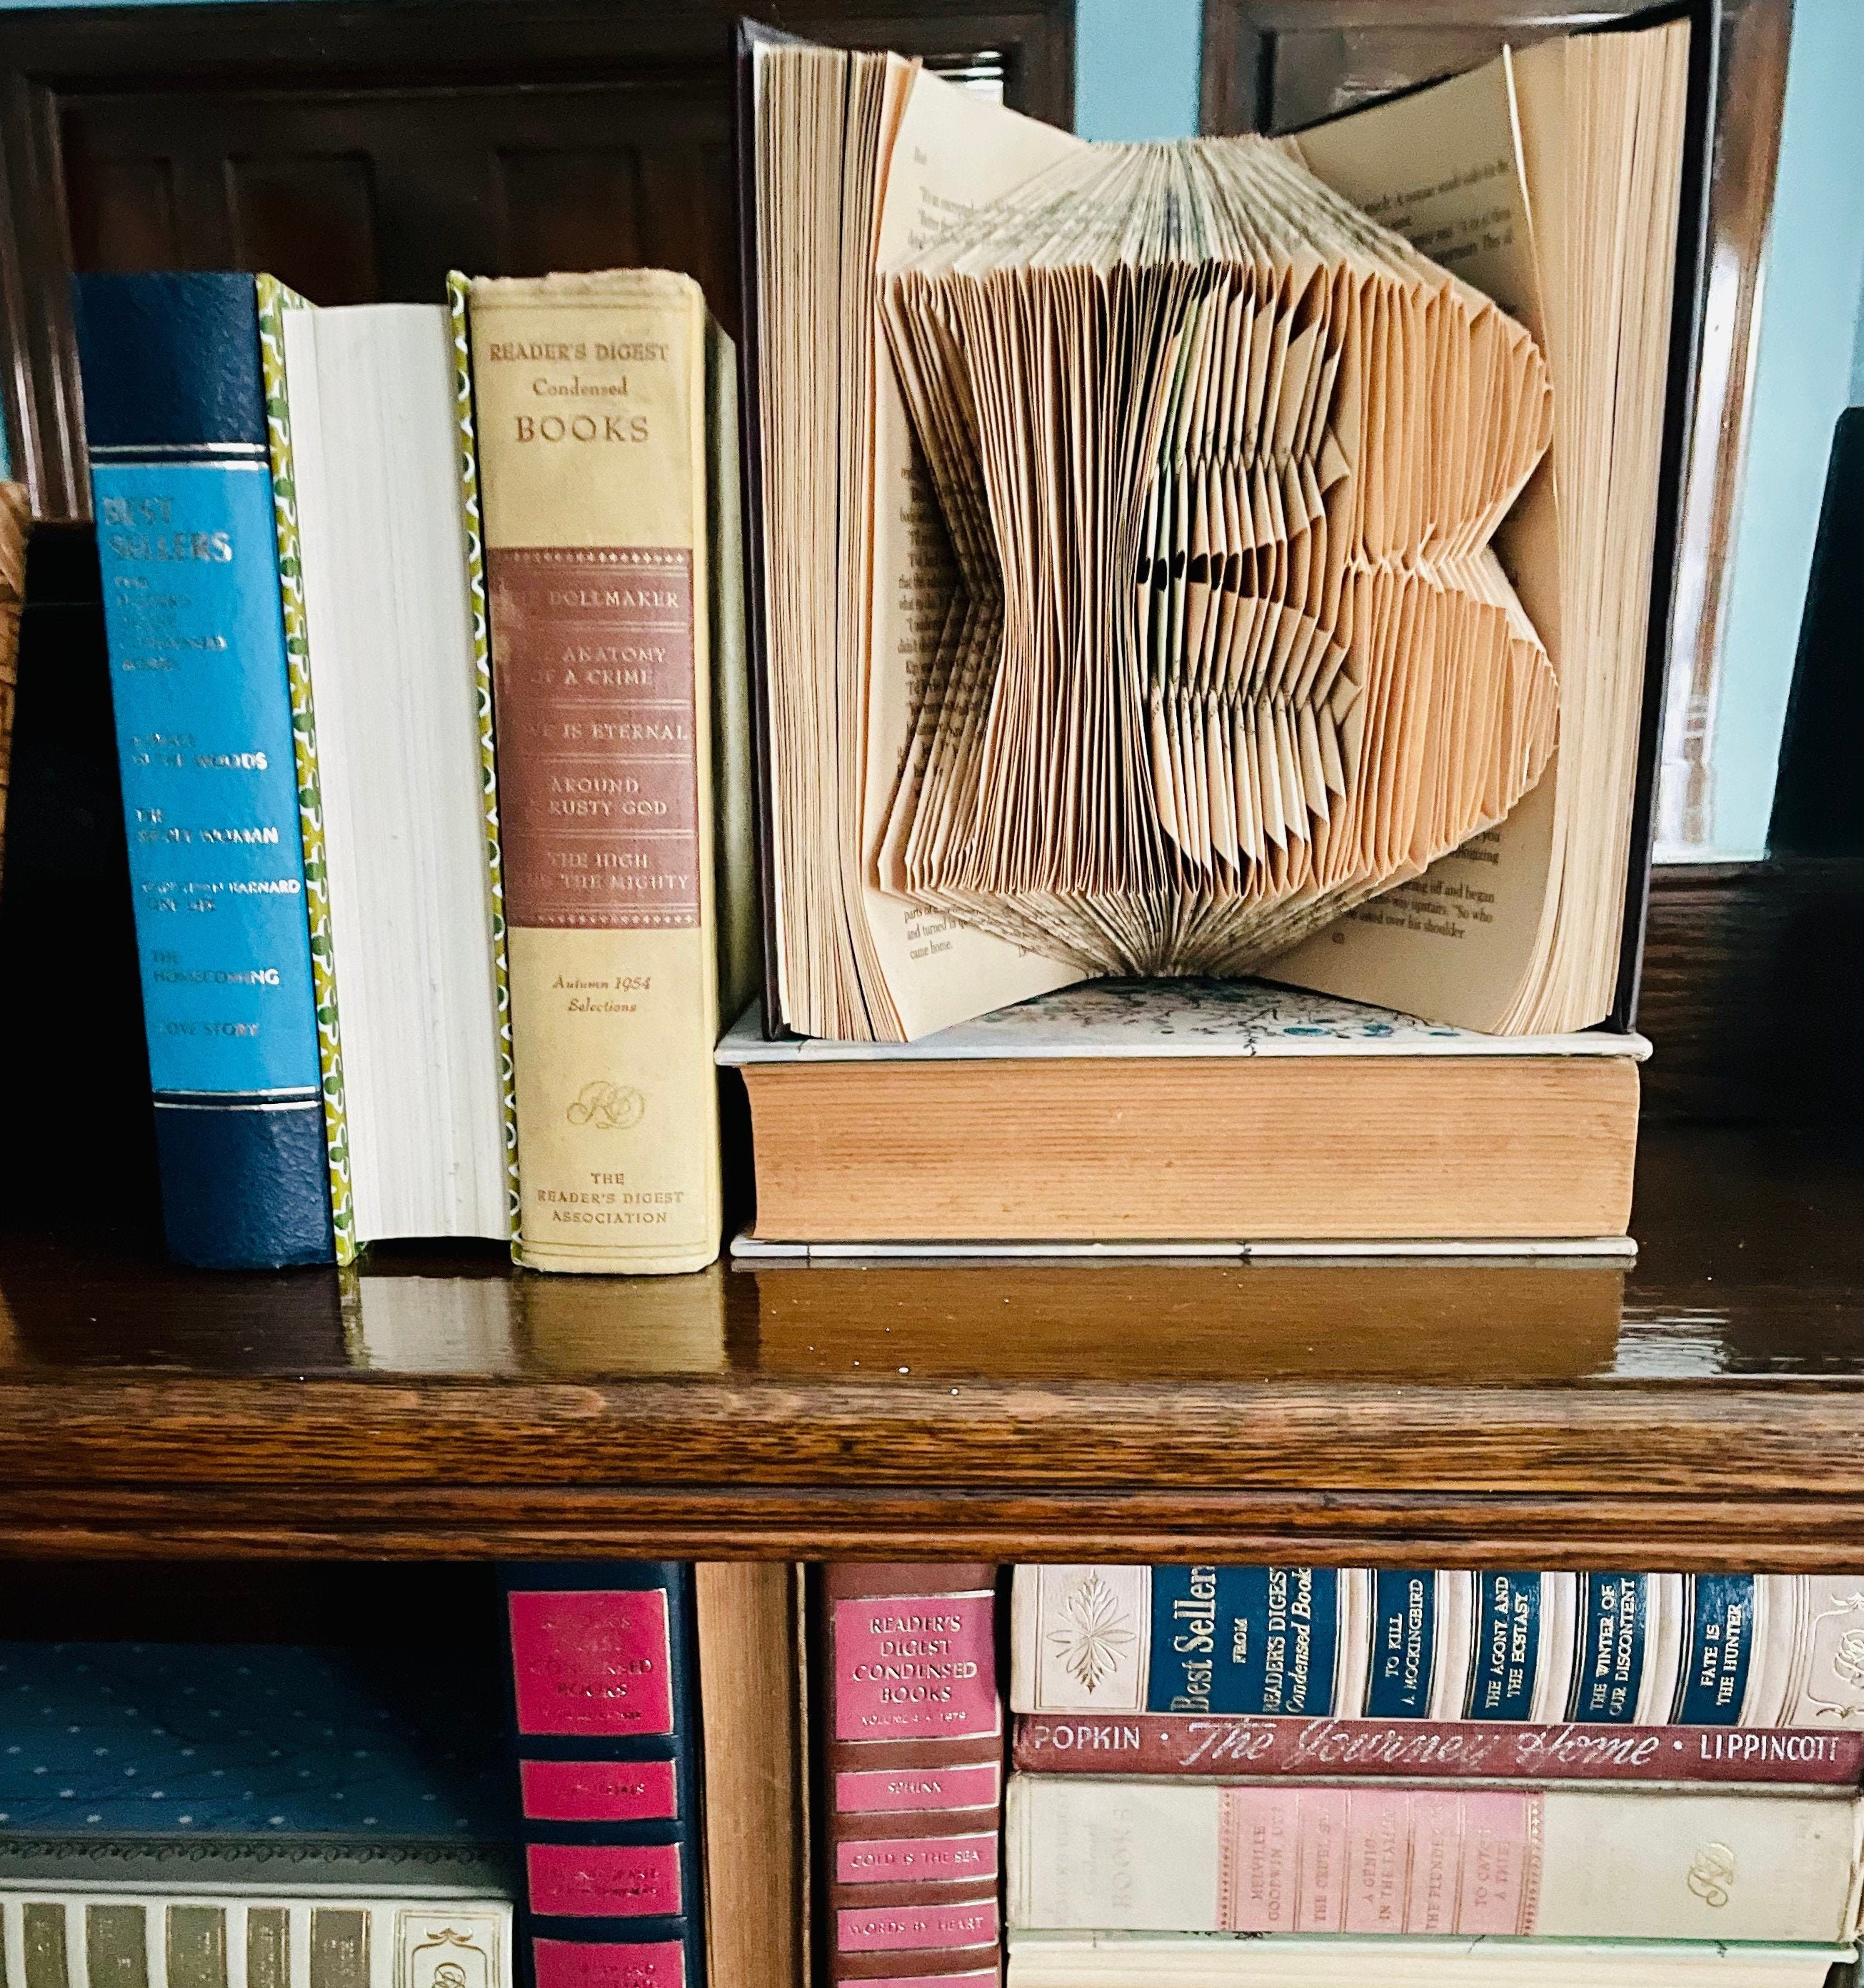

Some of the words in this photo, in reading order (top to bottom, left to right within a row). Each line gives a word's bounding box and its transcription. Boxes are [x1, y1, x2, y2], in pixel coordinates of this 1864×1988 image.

[489, 342, 587, 361] READER'S
[595, 341, 669, 362] DIGEST
[533, 375, 628, 396] Condensed
[514, 415, 649, 444] BOOKS
[563, 646, 666, 663] ANATOMY
[564, 669, 578, 686] A
[588, 669, 654, 686] CRIME
[563, 723, 583, 740] IS
[593, 723, 690, 741] ETERNAL
[551, 777, 639, 794] AROUND
[548, 800, 612, 817] RUSTY
[621, 800, 668, 815] GOD
[548, 852, 588, 869] THE
[596, 853, 649, 869] HIGH
[561, 873, 603, 890] THE
[610, 874, 690, 891] MIGHTY
[552, 975, 608, 990] Autumn
[614, 976, 651, 990] 1954
[568, 997, 637, 1013] Selections
[591, 1173, 626, 1185] THE
[537, 1190, 616, 1205] READER'S
[623, 1190, 685, 1205] DIGEST
[551, 1210, 668, 1225] ASSOCIATION
[1494, 1576, 1510, 1615] AND
[1601, 1584, 1616, 1610] OF
[868, 1615, 962, 1635] READER'S
[1388, 1612, 1403, 1651] KILL
[1404, 1578, 1424, 1690] MOCKINGBIRD
[1511, 1591, 1529, 1663] ECSTASY
[1615, 1577, 1636, 1682] DISCONTENT
[1706, 1624, 1721, 1642] IS
[1723, 1603, 1743, 1672] HUNTER
[881, 1639, 952, 1657] DIGEST
[1233, 1617, 1248, 1664] FROM
[1490, 1620, 1508, 1675] AGONY
[1595, 1615, 1615, 1678] WINTER
[852, 1661, 978, 1682] CONDENSED
[1286, 1622, 1311, 1714] Condensed
[1385, 1656, 1400, 1678] TO
[1700, 1646, 1720, 1687] FATE
[880, 1685, 952, 1705] BOOKS
[1169, 1658, 1213, 1714] Best
[1485, 1680, 1503, 1710] THE
[1507, 1667, 1524, 1698] THE
[1715, 1676, 1735, 1707] THE
[1400, 1695, 1415, 1706] A
[1589, 1682, 1609, 1712] THE
[1608, 1686, 1628, 1717] OUR
[1033, 1725, 1141, 1751] POPKIN
[1178, 1719, 1278, 1767] The
[1700, 1734, 1840, 1763] LIPPINCOTT
[953, 1849, 981, 1864] SEA
[1251, 1824, 1268, 1902] MELVILLE
[1268, 1845, 1283, 1922] GOODWIN
[1381, 1872, 1393, 1898] THE
[1497, 1889, 1508, 1903] A
[1314, 1894, 1328, 1922] THE
[1362, 1894, 1375, 1905] A
[1475, 1884, 1488, 1909] TO
[1378, 1904, 1392, 1922] IN
[1425, 1902, 1440, 1931] THE
